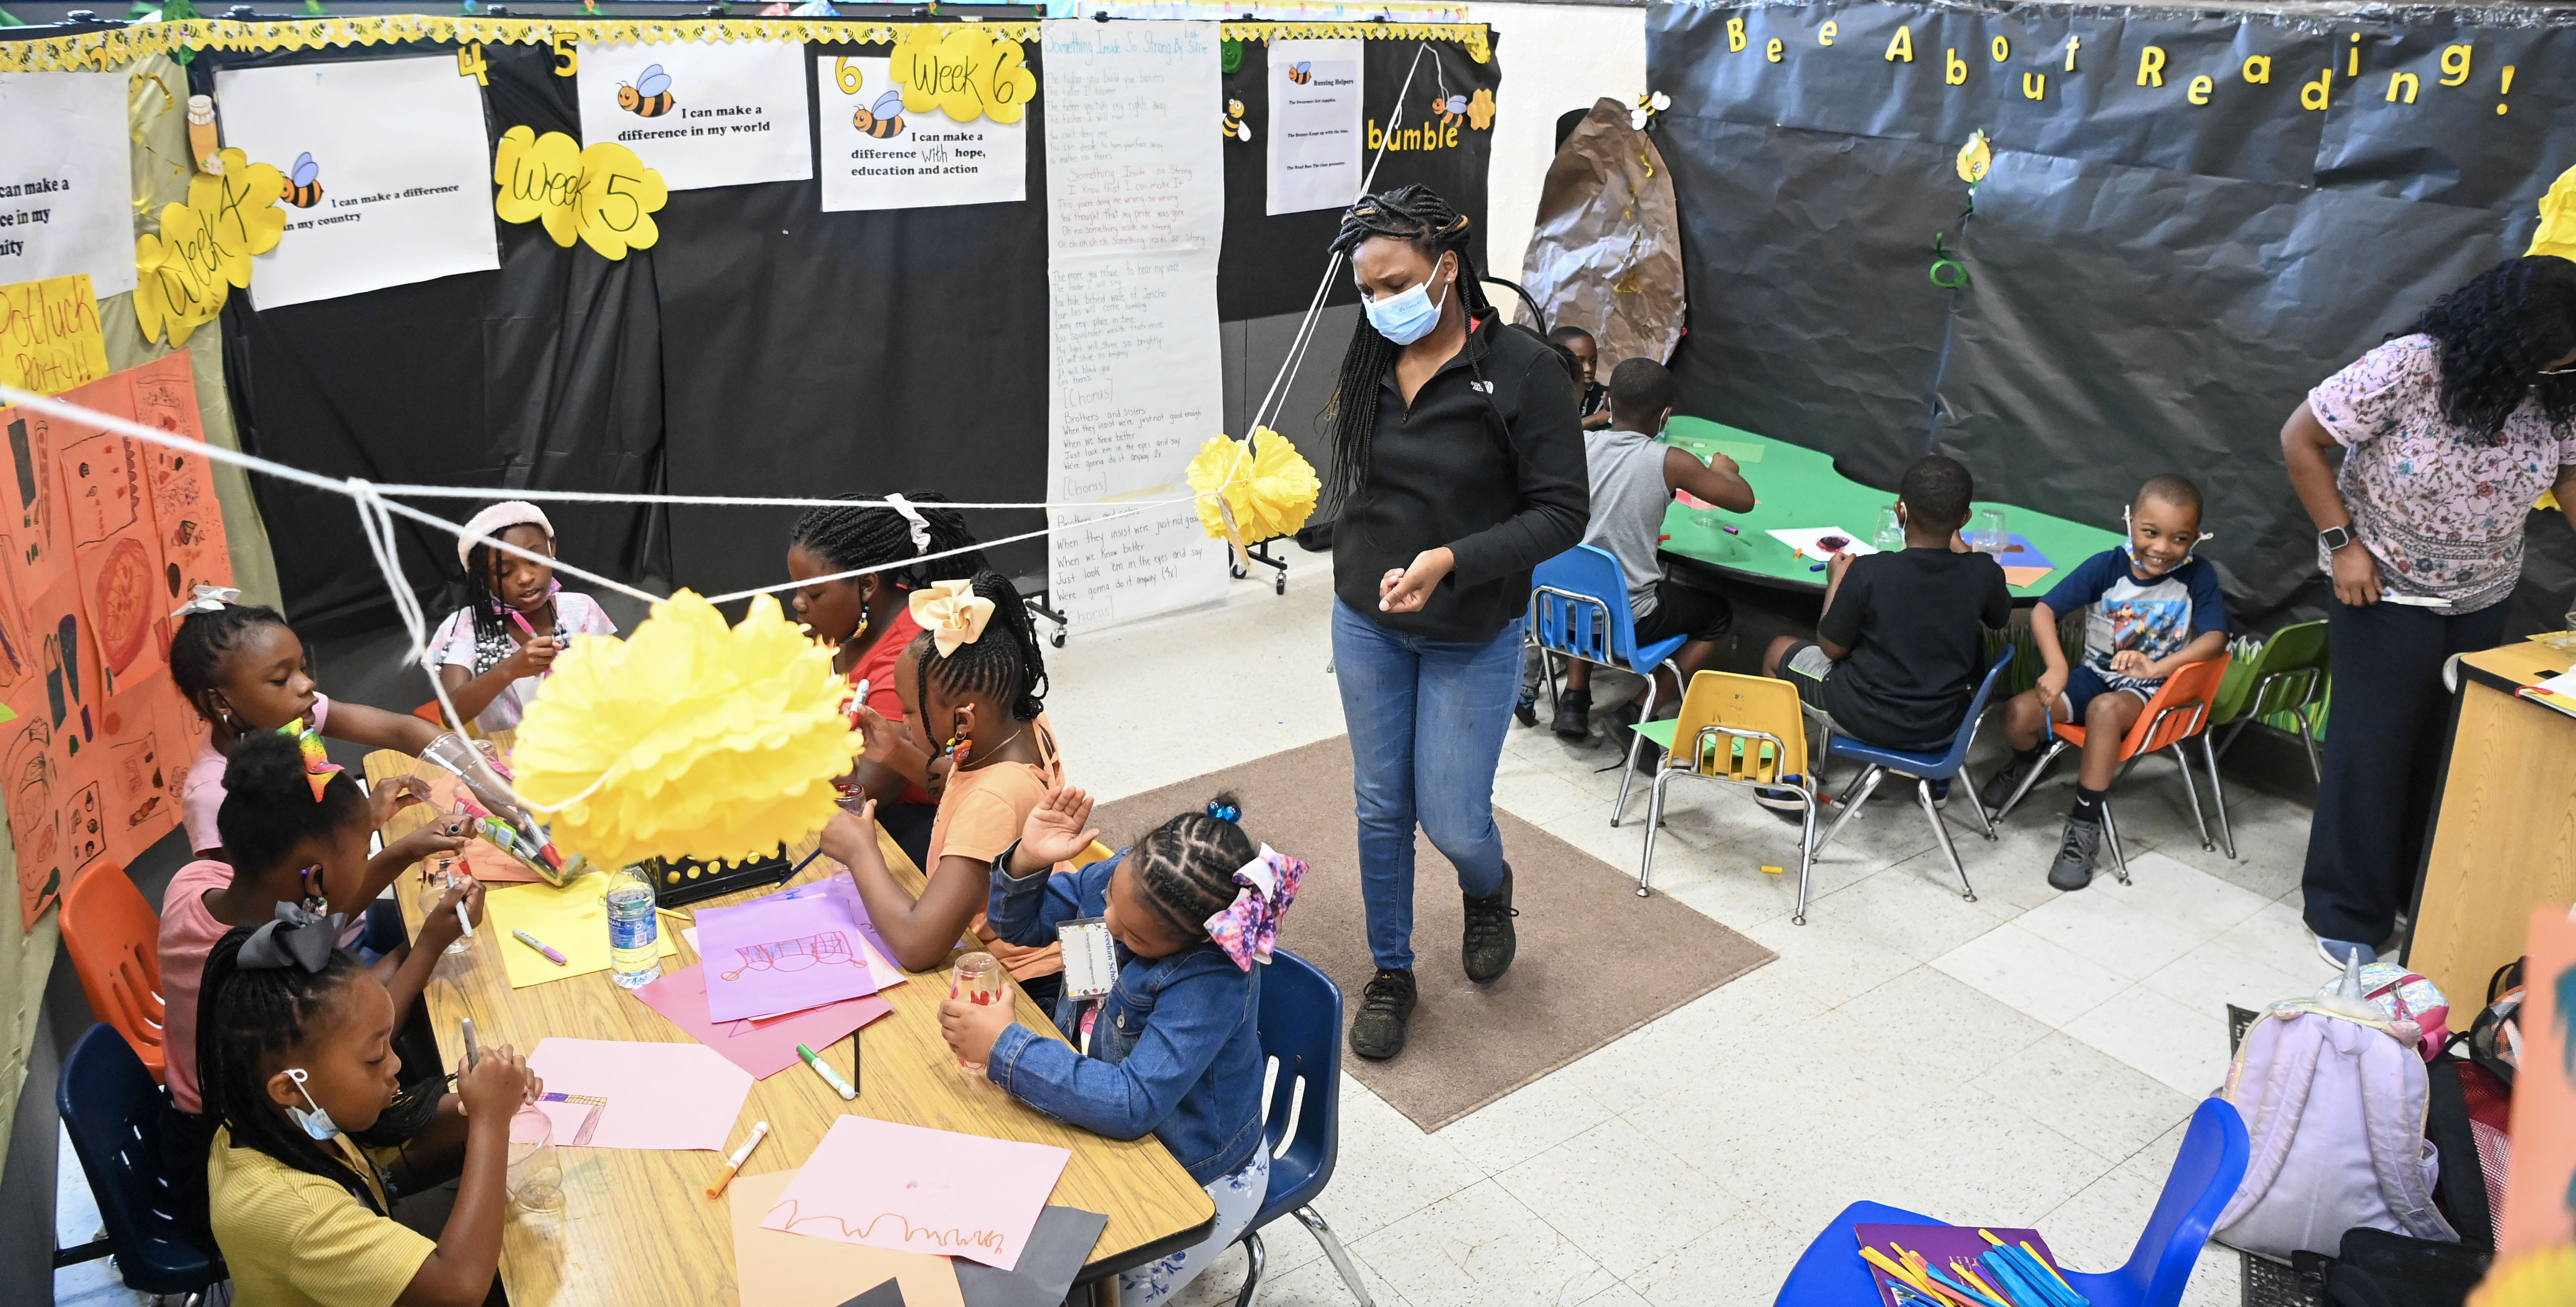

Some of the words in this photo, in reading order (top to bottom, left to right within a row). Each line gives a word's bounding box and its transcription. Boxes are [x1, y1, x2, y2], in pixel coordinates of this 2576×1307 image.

[553, 32, 578, 77] 5
[1044, 27, 1094, 66] Something
[1143, 30, 1172, 65] Strong
[458, 42, 489, 87] 4
[835, 56, 863, 95] 6
[1726, 17, 1838, 63] Bee
[1885, 24, 2081, 100] About
[2136, 32, 2516, 116] Reading!
[913, 53, 984, 106] Week
[993, 52, 1014, 104] 6
[682, 108, 687, 119] I
[690, 108, 712, 118] can
[716, 106, 752, 117] make
[618, 128, 687, 142] difference
[691, 126, 704, 137] in
[707, 126, 727, 137] my
[731, 121, 771, 133] world
[911, 132, 916, 142] I
[919, 132, 940, 142] can
[943, 131, 974, 141] make
[1368, 119, 1458, 151] bumble
[851, 149, 917, 160] difference
[922, 143, 948, 163] with
[955, 148, 986, 159] hope,
[851, 166, 915, 176] education
[918, 165, 940, 175] and
[943, 165, 978, 174] action
[1067, 167, 1115, 185] Something
[0, 184, 22, 198] can
[24, 178, 58, 195] make
[62, 179, 70, 191] a
[331, 199, 337, 208] I
[339, 198, 358, 208] can
[361, 193, 391, 205] make
[403, 184, 459, 198] difference
[513, 157, 591, 229] Week
[599, 174, 641, 232] 5
[17, 209, 29, 225] in
[31, 209, 50, 224] my
[220, 174, 251, 243] 4
[1104, 208, 1118, 220] that
[297, 220, 314, 230] my
[317, 213, 361, 226] country
[157, 209, 235, 317] Week
[1063, 425, 1079, 436] When
[1083, 423, 1095, 435] they
[1170, 410, 1183, 424] good
[1065, 411, 1099, 424] Brothers
[1108, 409, 1121, 419] and
[1064, 439, 1081, 448] When
[1115, 430, 1135, 441] better
[1065, 449, 1080, 460] Just
[1157, 437, 1168, 446] and
[1171, 437, 1181, 448] say
[1086, 459, 1104, 472] gonna
[1057, 538, 1078, 550] When
[1086, 529, 1104, 548] they
[1057, 556, 1080, 568] When
[1123, 541, 1145, 554] better
[1056, 572, 1075, 585] Just
[1128, 560, 1136, 569] in
[1139, 555, 1151, 566] the
[1154, 554, 1168, 566] eyes
[1173, 548, 1186, 559] and
[1191, 548, 1202, 560] say
[1088, 583, 1110, 600] gonna
[1116, 579, 1124, 588] do
